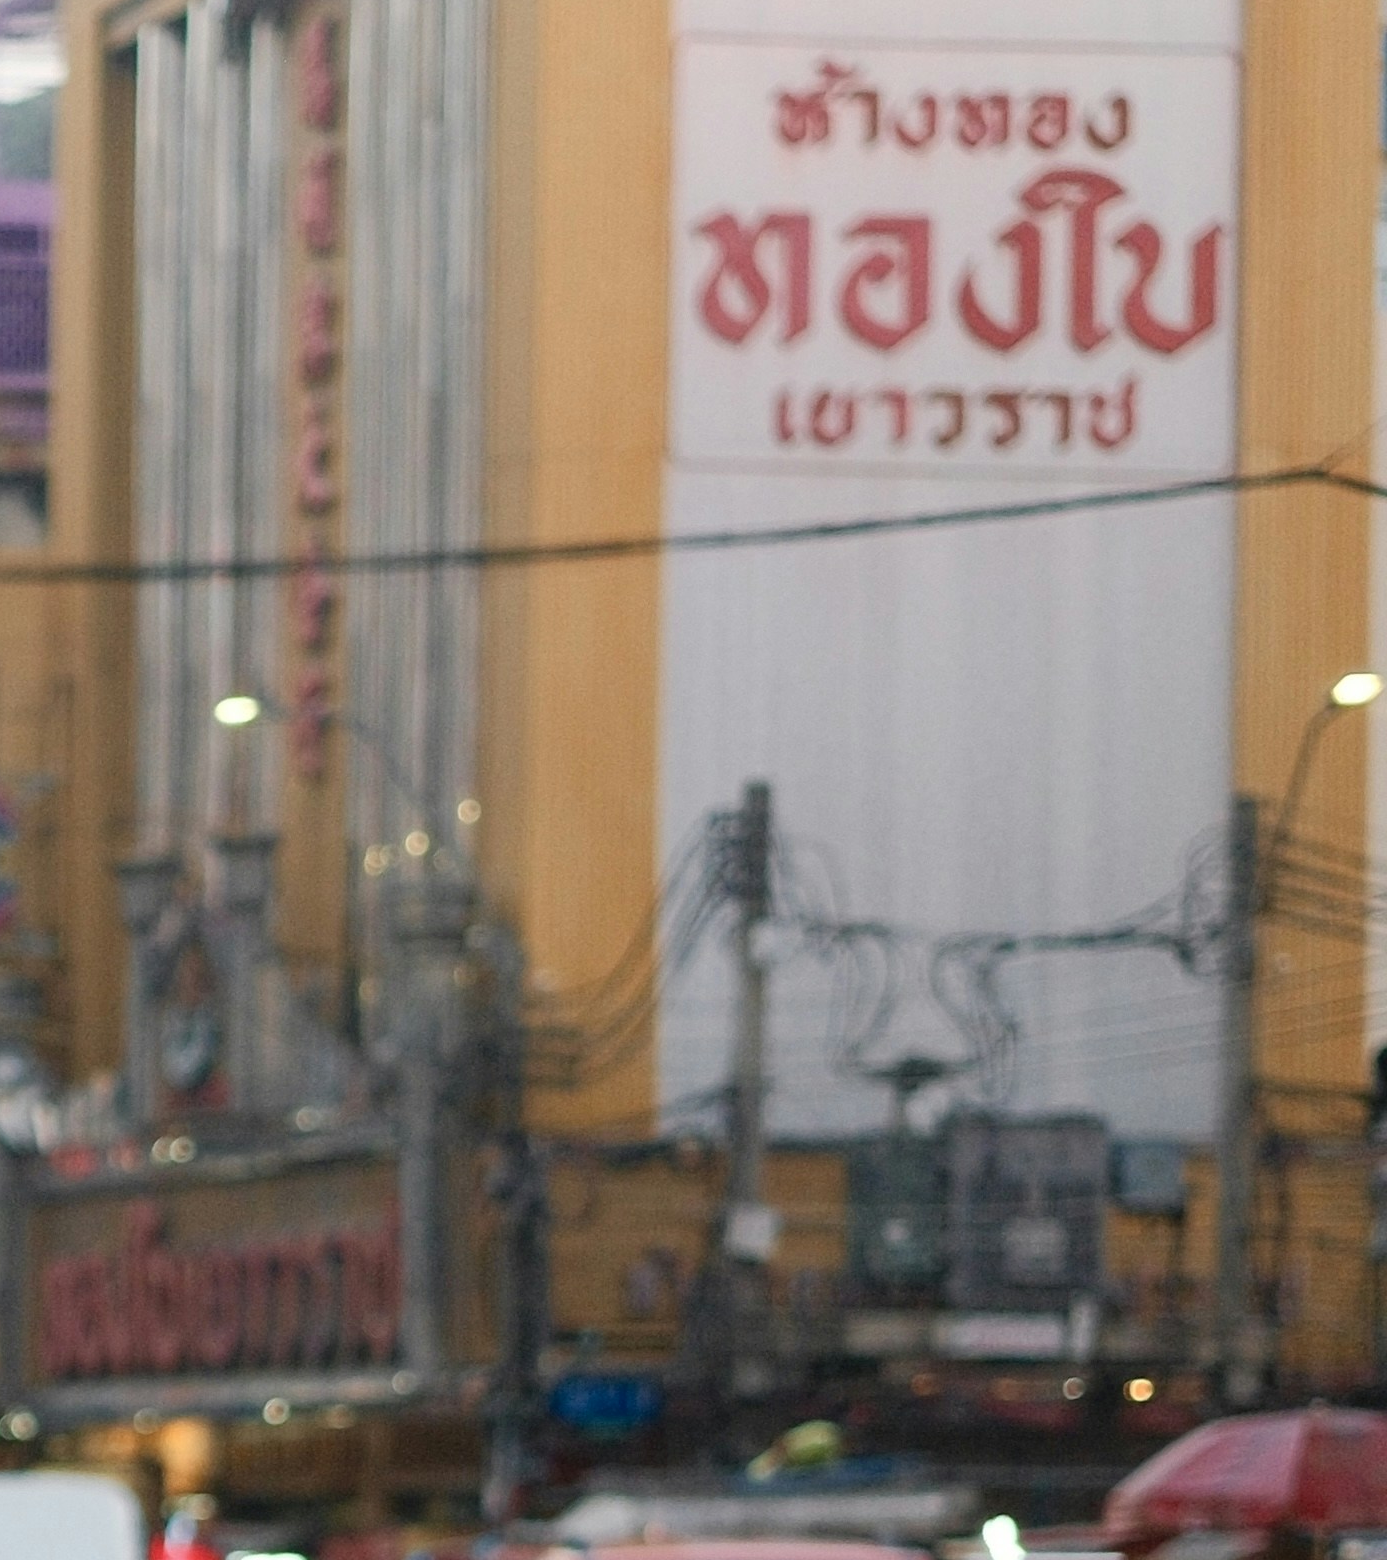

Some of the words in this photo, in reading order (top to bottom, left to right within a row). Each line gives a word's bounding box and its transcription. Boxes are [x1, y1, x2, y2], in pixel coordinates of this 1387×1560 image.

[774, 62, 1134, 151] ห้างทอง
[774, 371, 1137, 449] เยาวราช
